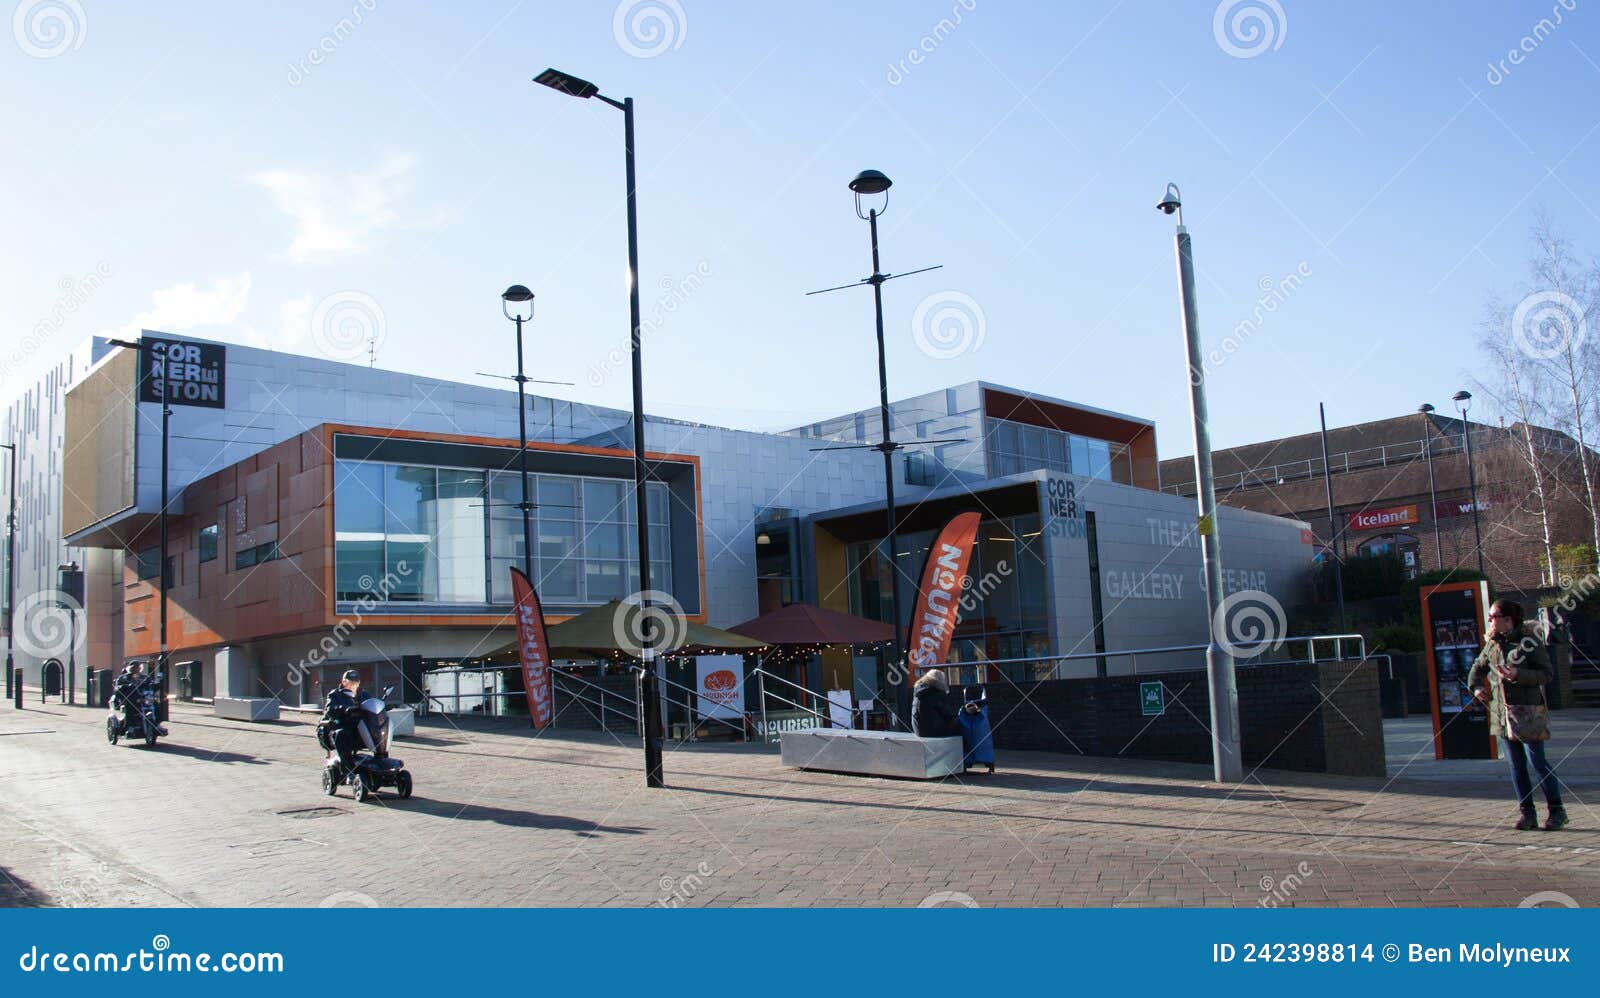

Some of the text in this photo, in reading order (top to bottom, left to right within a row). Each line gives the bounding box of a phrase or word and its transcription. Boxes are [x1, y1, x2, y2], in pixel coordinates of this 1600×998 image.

[1048, 478, 1075, 498] COR
[1358, 510, 1408, 526] Iceland
[1106, 571, 1184, 600] GALLERY
